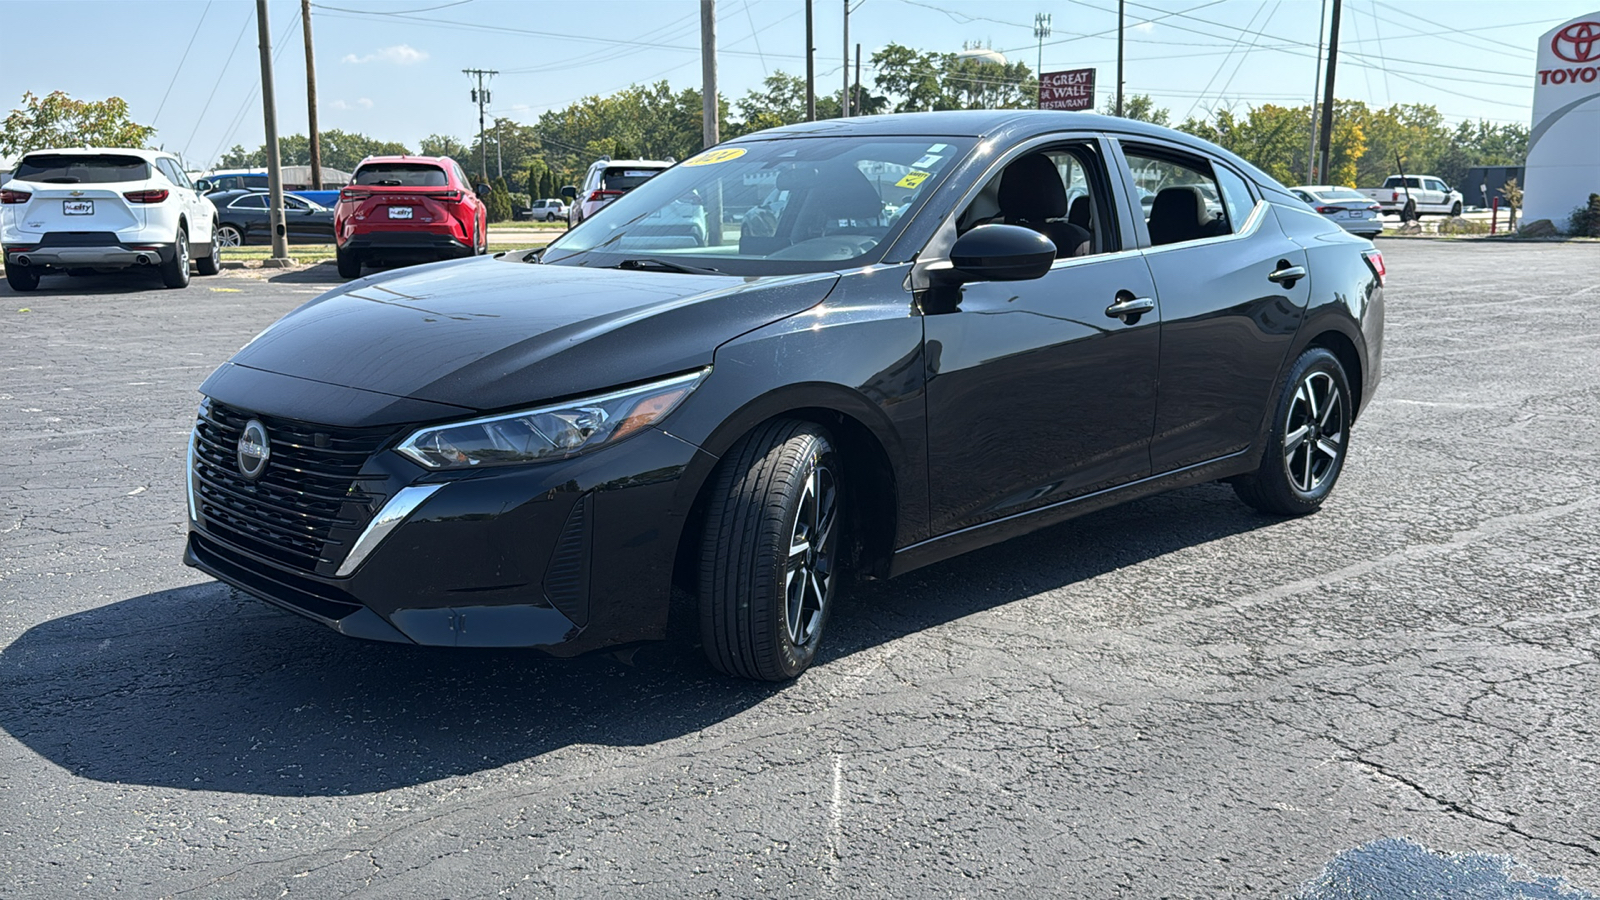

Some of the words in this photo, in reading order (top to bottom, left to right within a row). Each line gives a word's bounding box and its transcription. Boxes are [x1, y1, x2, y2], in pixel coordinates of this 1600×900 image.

[1053, 72, 1089, 86] GREAT
[1538, 67, 1600, 85] TOYO
[1053, 85, 1087, 98] WALL
[1040, 98, 1088, 110] RESTAURANT
